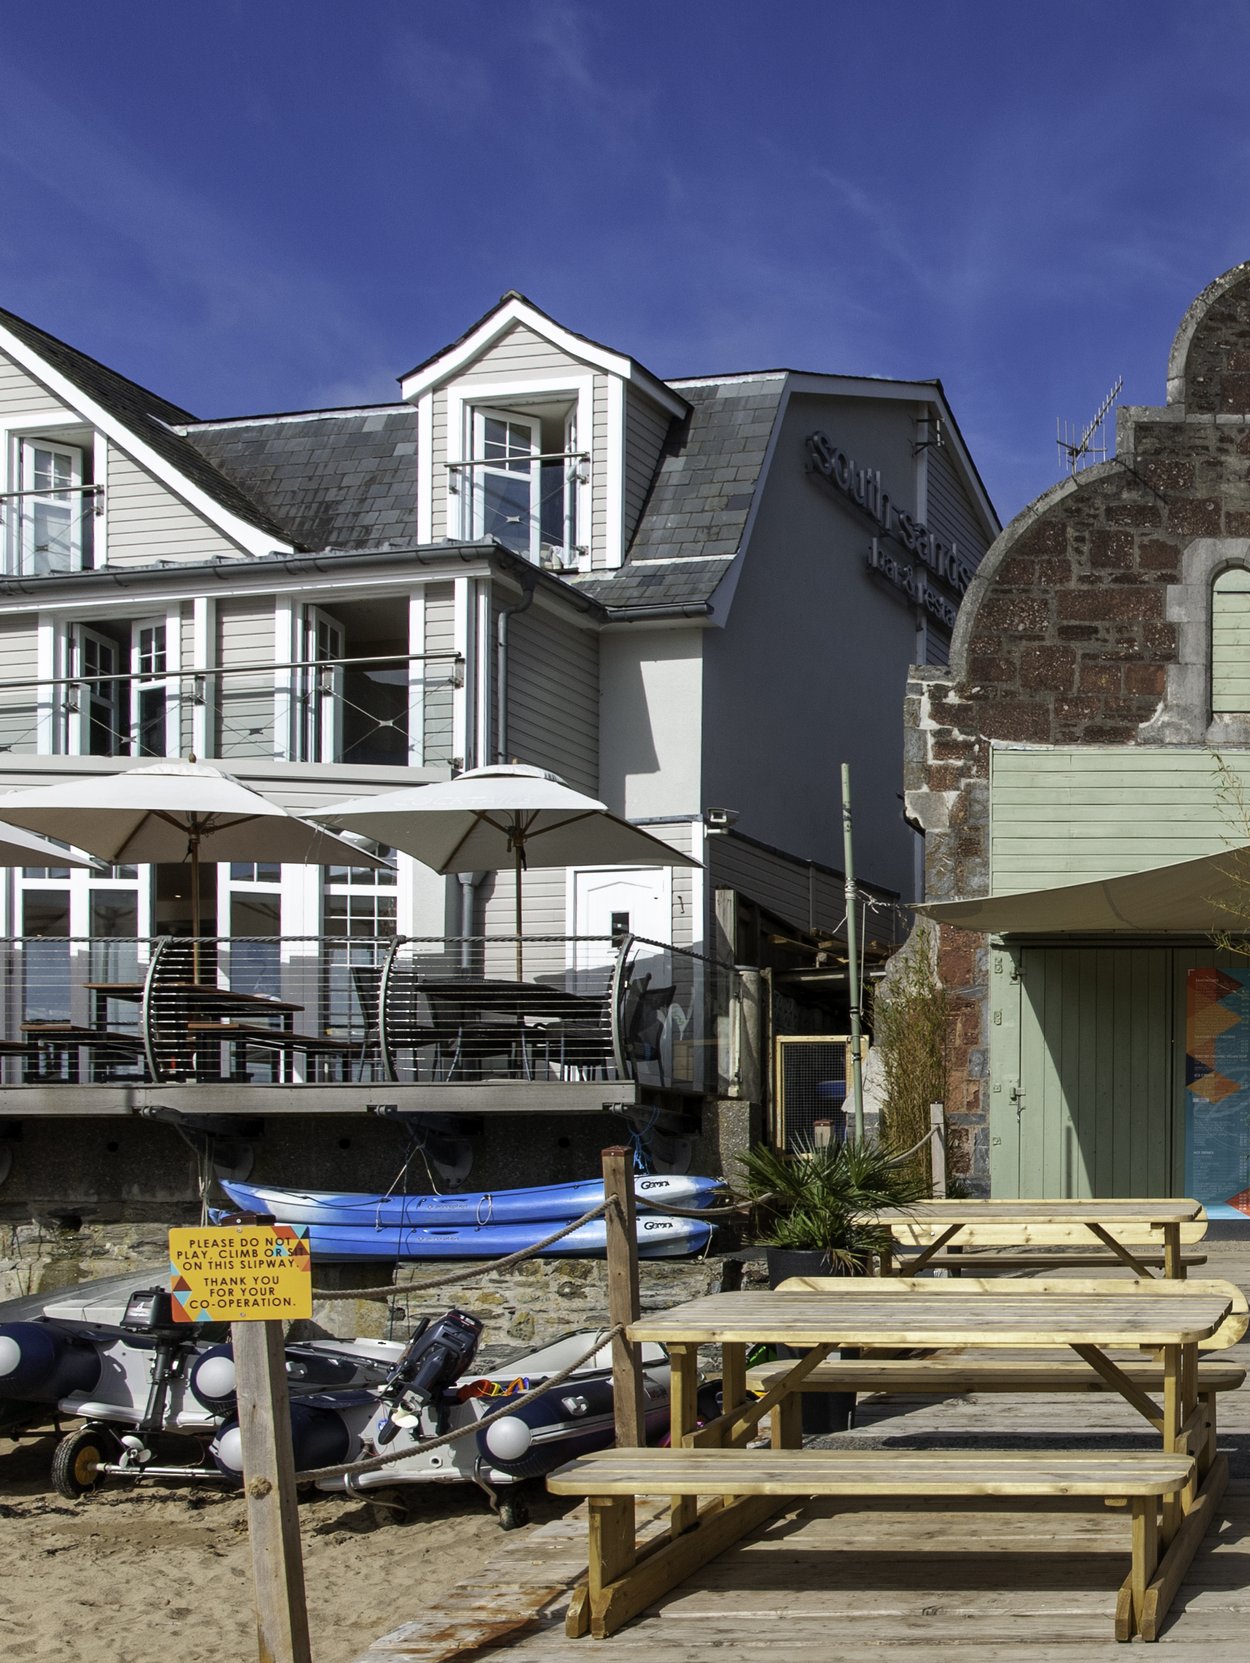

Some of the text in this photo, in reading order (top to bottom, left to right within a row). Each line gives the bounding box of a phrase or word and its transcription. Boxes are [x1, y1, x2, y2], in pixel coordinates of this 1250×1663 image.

[808, 430, 892, 529] South
[868, 537, 901, 588] bar
[189, 1237, 291, 1248] PLEASE DO NOT
[177, 1248, 304, 1260] PLAY, CLIMB OR SIT
[183, 1259, 300, 1271] ON THIS SLIPWAY.
[204, 1276, 279, 1286] THANK YOU
[210, 1287, 275, 1297] FOR YOUR
[189, 1297, 296, 1309] CO-OPERATION.
